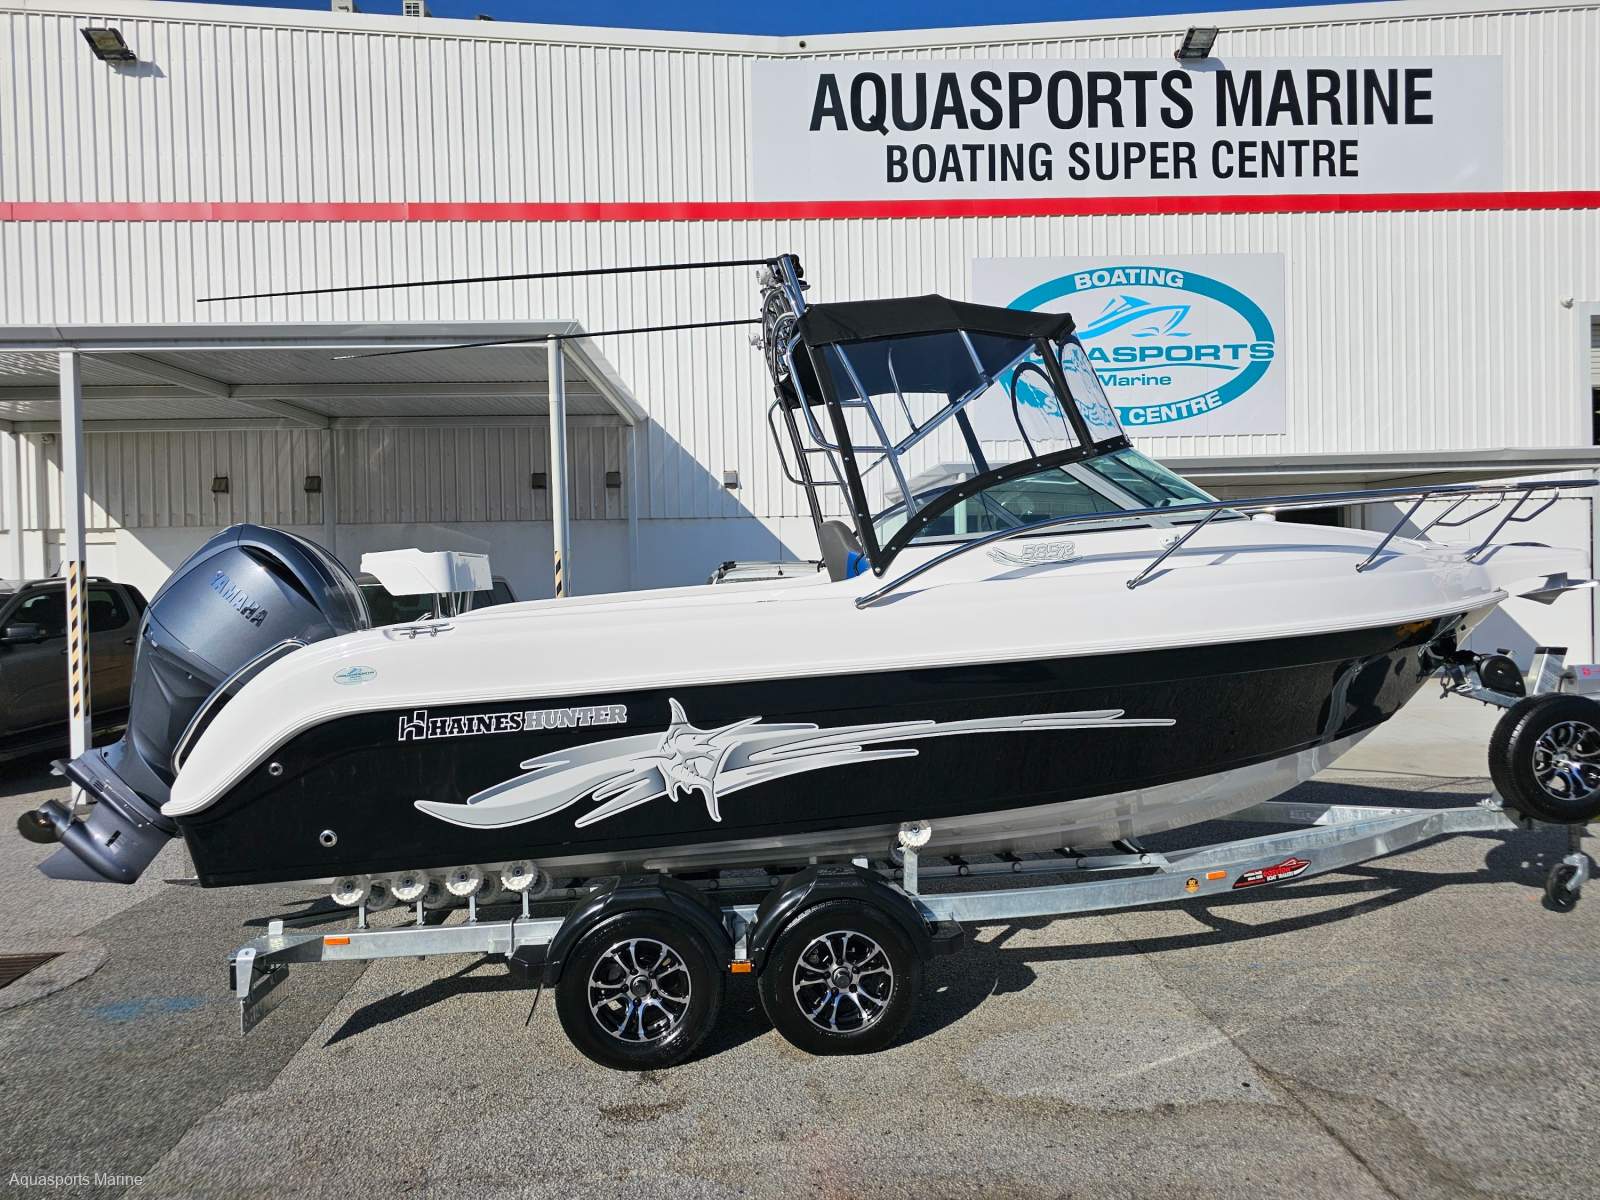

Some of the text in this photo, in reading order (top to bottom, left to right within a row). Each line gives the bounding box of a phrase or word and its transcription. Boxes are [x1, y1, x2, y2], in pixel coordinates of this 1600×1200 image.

[810, 69, 1434, 136] AQUASPORTS MARINE
[886, 139, 1360, 183] BOATING SUPER CENTRE
[1074, 268, 1185, 291] BOATING
[1128, 391, 1223, 424] CENTRE
[209, 570, 268, 627] YAMAHA
[427, 711, 523, 738] HAINES
[523, 704, 628, 731] HUNTER
